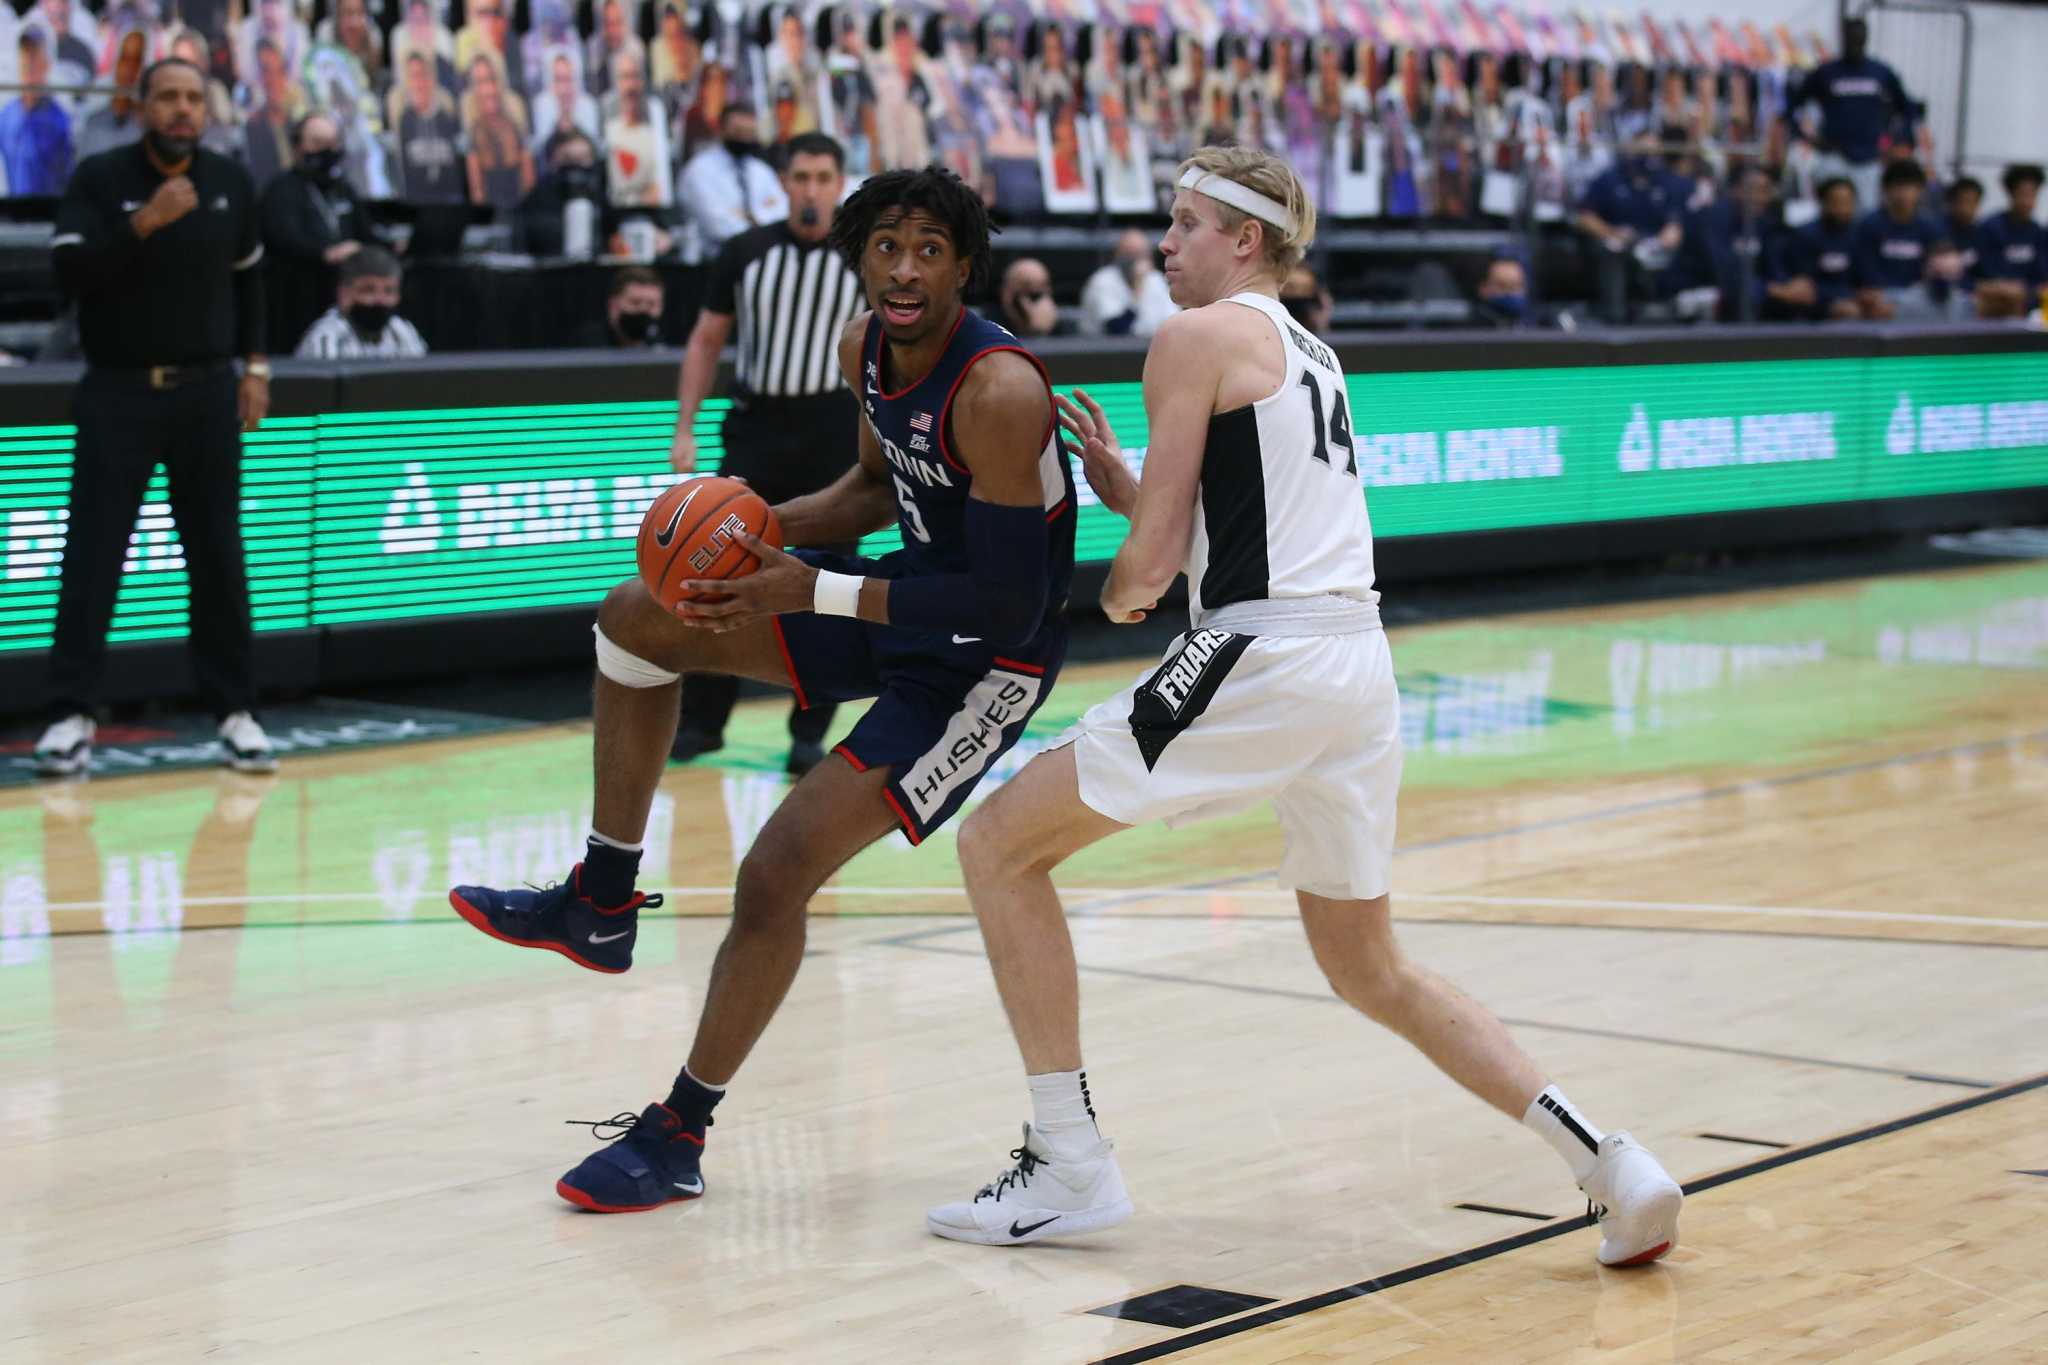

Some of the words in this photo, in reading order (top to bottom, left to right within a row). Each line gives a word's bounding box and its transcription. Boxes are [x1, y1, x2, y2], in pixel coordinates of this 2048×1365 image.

[1298, 369, 1358, 478] 14
[688, 513, 748, 573] ELITE
[892, 473, 932, 543] 5
[1155, 628, 1233, 712] FRIARS
